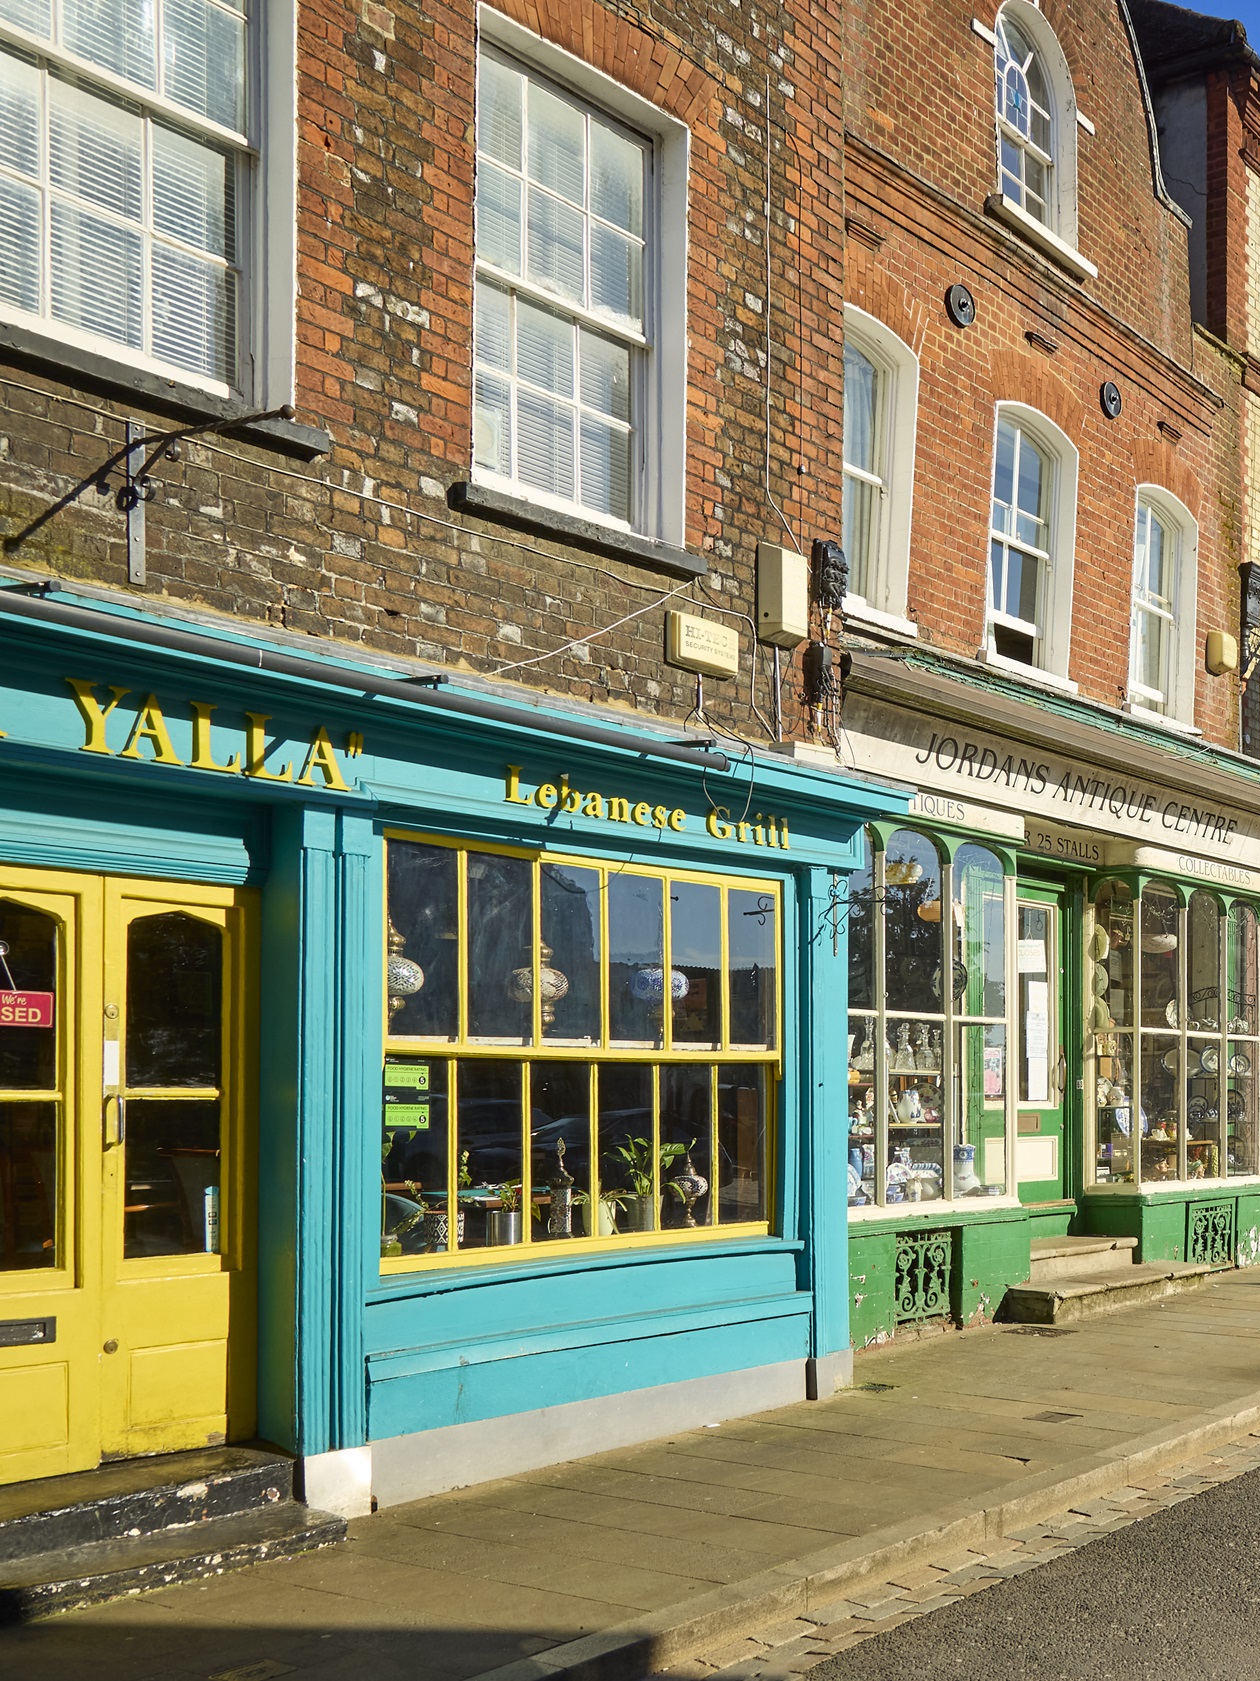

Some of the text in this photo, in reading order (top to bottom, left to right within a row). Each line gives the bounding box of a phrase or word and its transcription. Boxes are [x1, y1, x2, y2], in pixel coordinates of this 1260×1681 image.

[685, 625, 735, 651] HI-TEC
[685, 640, 714, 653] SECURITY
[915, 733, 1238, 845] JORDANS ANTIQUE CENTRE
[505, 764, 791, 850] Lebanese Grill
[1037, 833, 1052, 851] 25
[1057, 837, 1099, 861] STALLS
[1178, 856, 1251, 885] COLLECTABLES
[2, 994, 27, 1005] We're
